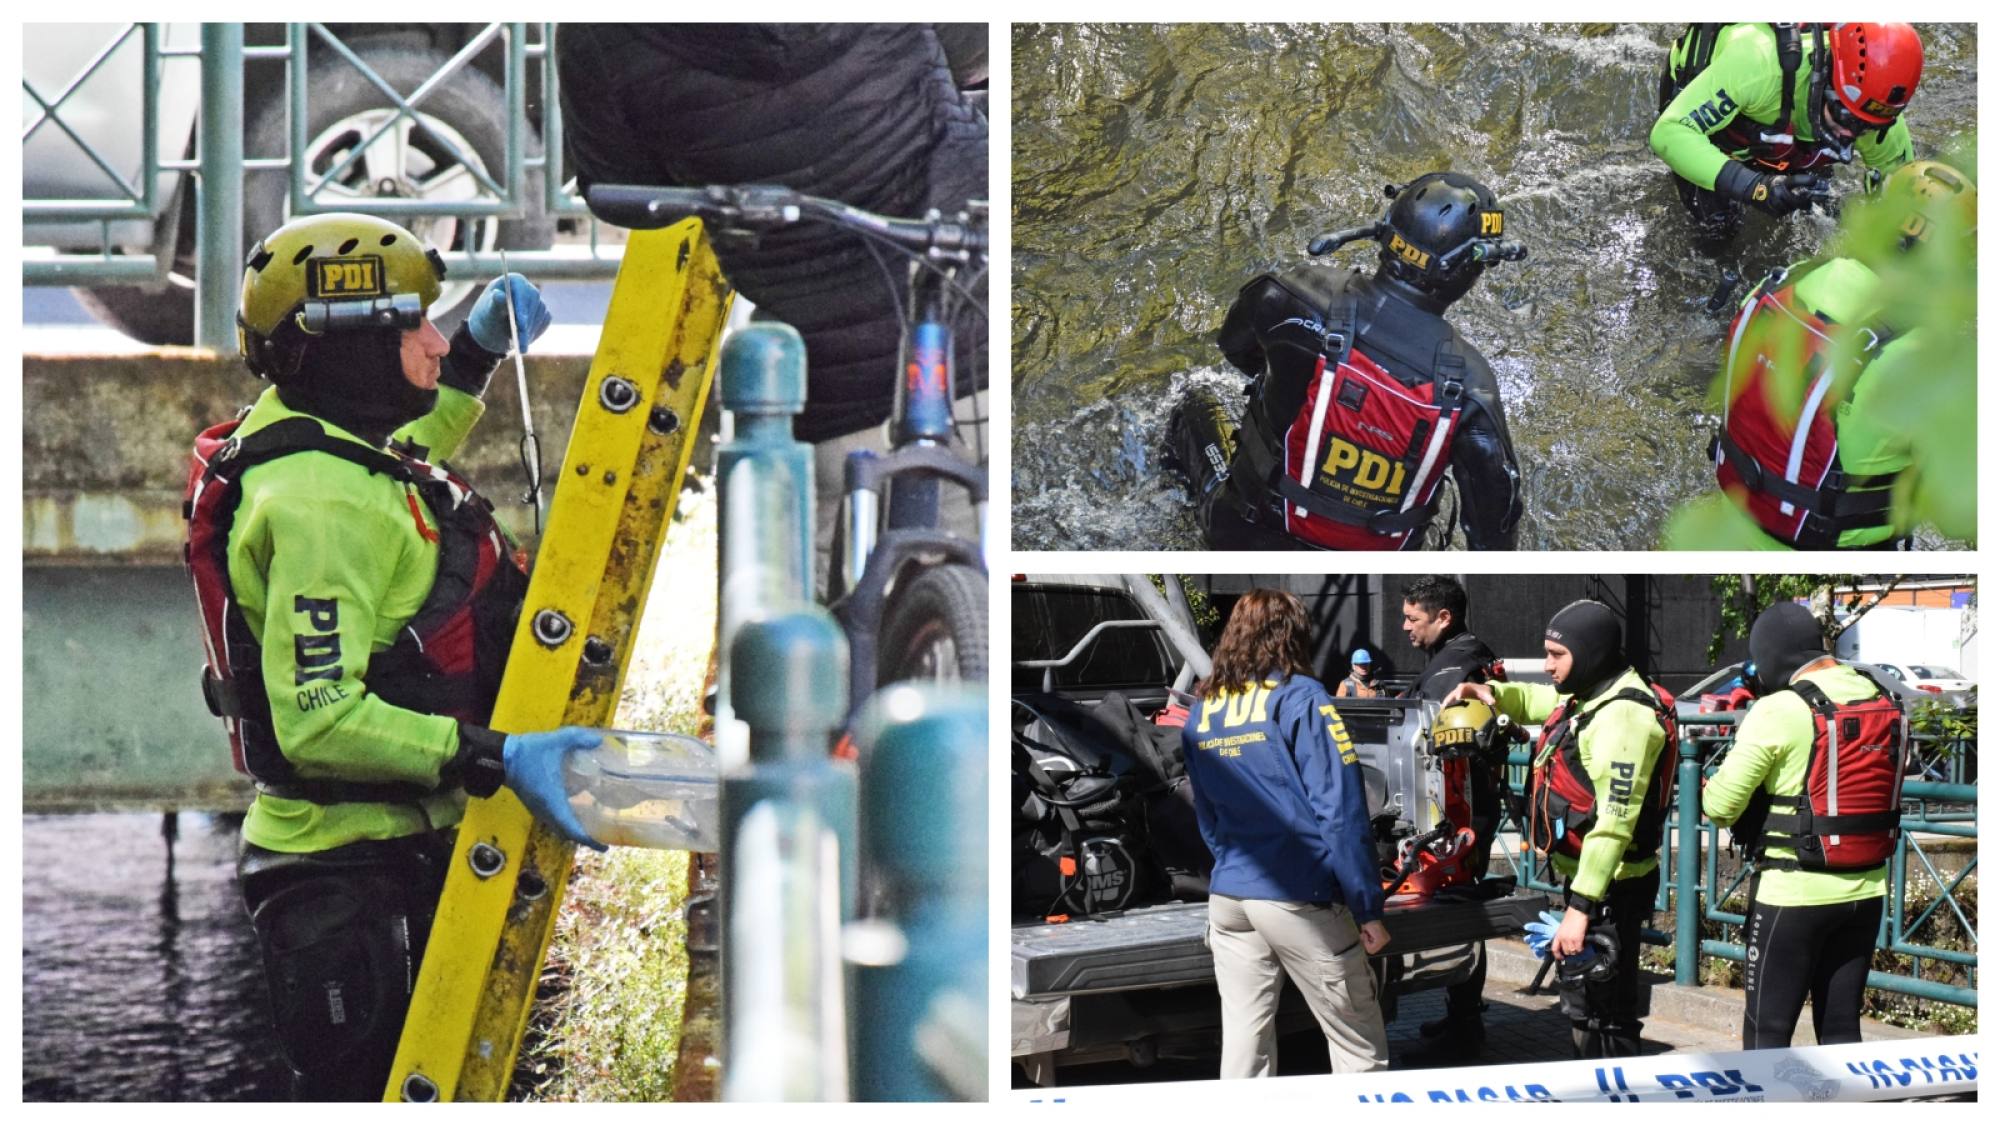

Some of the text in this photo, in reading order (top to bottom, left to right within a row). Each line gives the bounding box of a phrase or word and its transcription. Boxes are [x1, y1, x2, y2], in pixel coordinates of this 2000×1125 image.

[1690, 88, 1739, 134] PDI
[1481, 212, 1502, 234] PDI
[1389, 234, 1431, 270] PDI
[323, 263, 373, 290] PDI
[1321, 436, 1406, 495] PDI
[294, 594, 344, 687] PDI
[296, 684, 350, 712] CHILE
[1197, 680, 1278, 733] PDI
[1434, 728, 1465, 748] PDI
[1609, 761, 1635, 806] PDI
[1655, 1070, 1764, 1099] PDI
